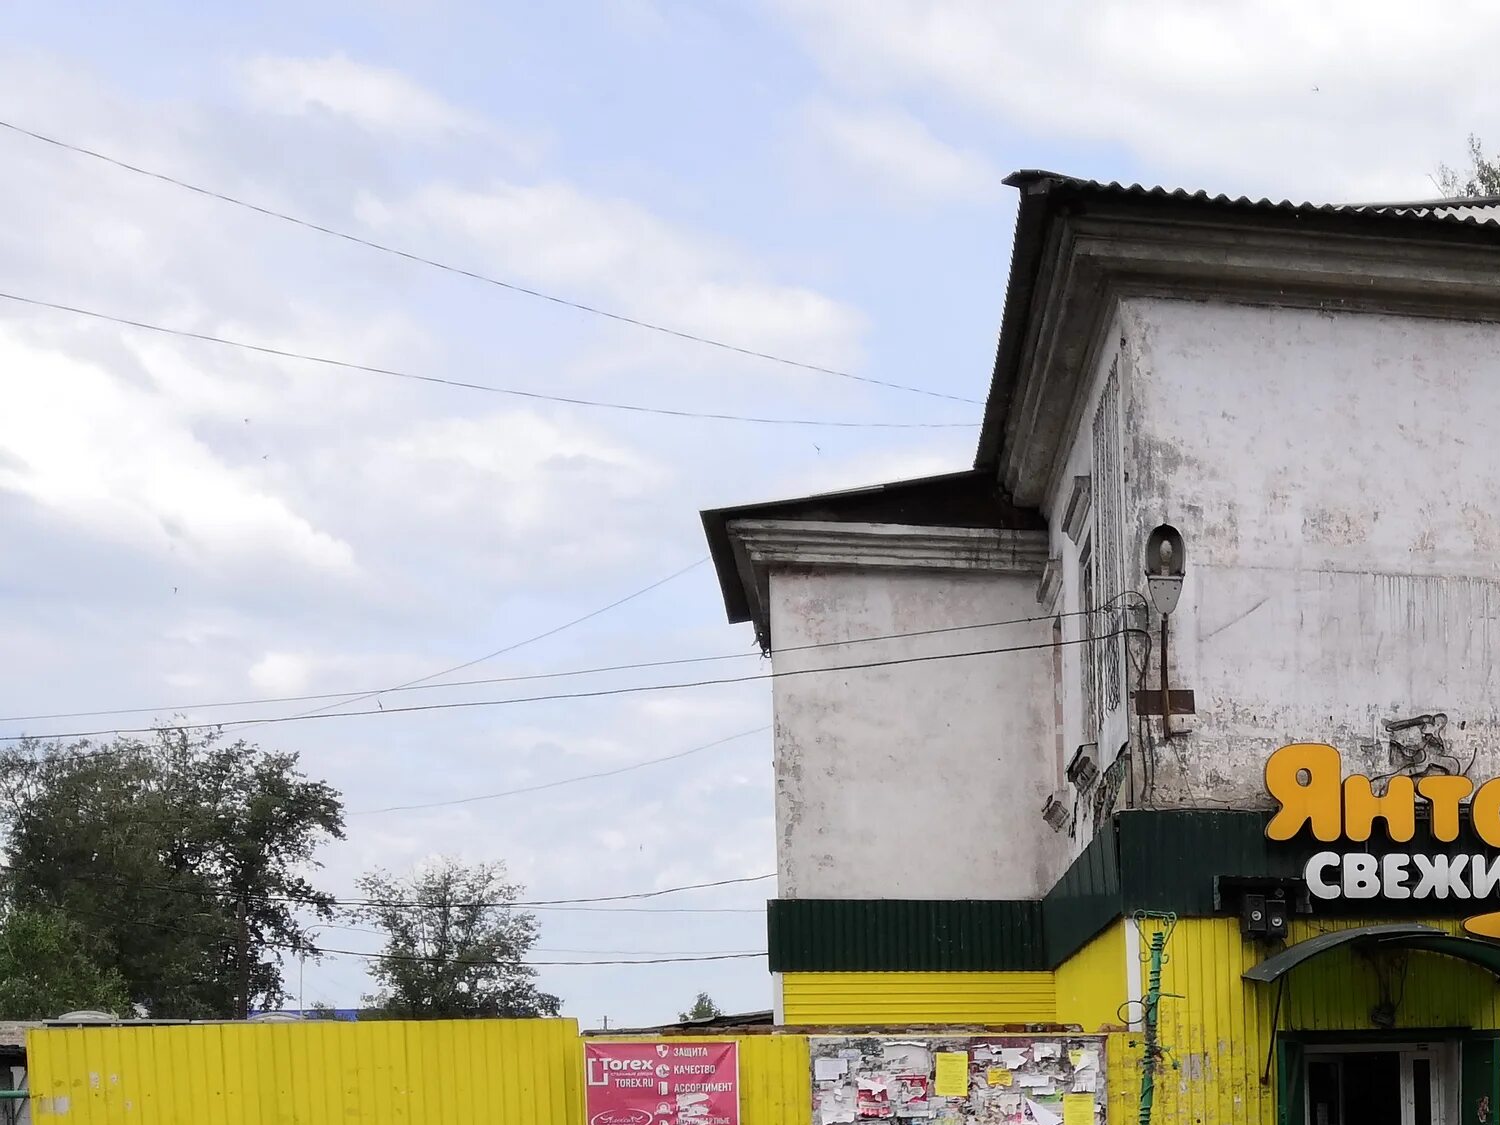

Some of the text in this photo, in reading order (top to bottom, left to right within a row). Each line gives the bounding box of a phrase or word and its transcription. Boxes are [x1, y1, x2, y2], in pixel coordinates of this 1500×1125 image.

[673, 1047, 708, 1057] ЗАЩИТА
[599, 1057, 654, 1071] Torex
[673, 1064, 716, 1075] КАЧЕСТВО
[615, 1078, 654, 1088] TOREX.RU
[674, 1082, 733, 1093] АССОРТИМЕНТ
